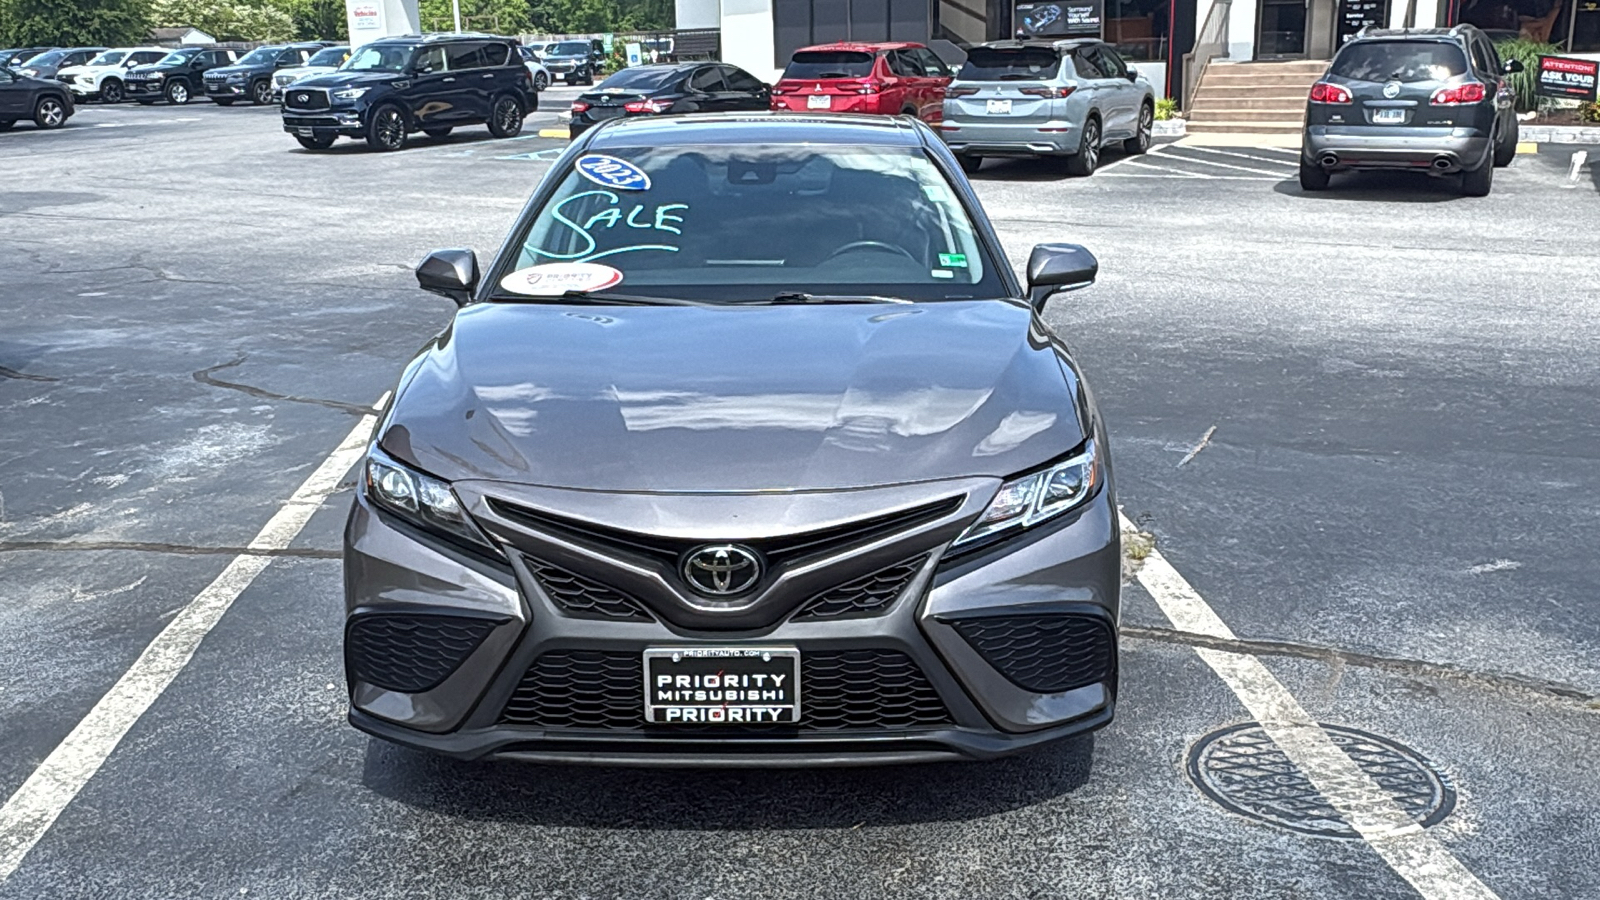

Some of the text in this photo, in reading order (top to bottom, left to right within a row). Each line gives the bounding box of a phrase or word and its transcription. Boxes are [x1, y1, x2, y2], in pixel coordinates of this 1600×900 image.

[1541, 70, 1563, 80] ASK
[1565, 72, 1594, 84] YOUR
[582, 158, 643, 186] 2023
[524, 190, 689, 259] SALE
[657, 674, 786, 688] PRIORITY
[658, 690, 784, 701] MITSUBISHI
[666, 708, 783, 722] PRIORITY
